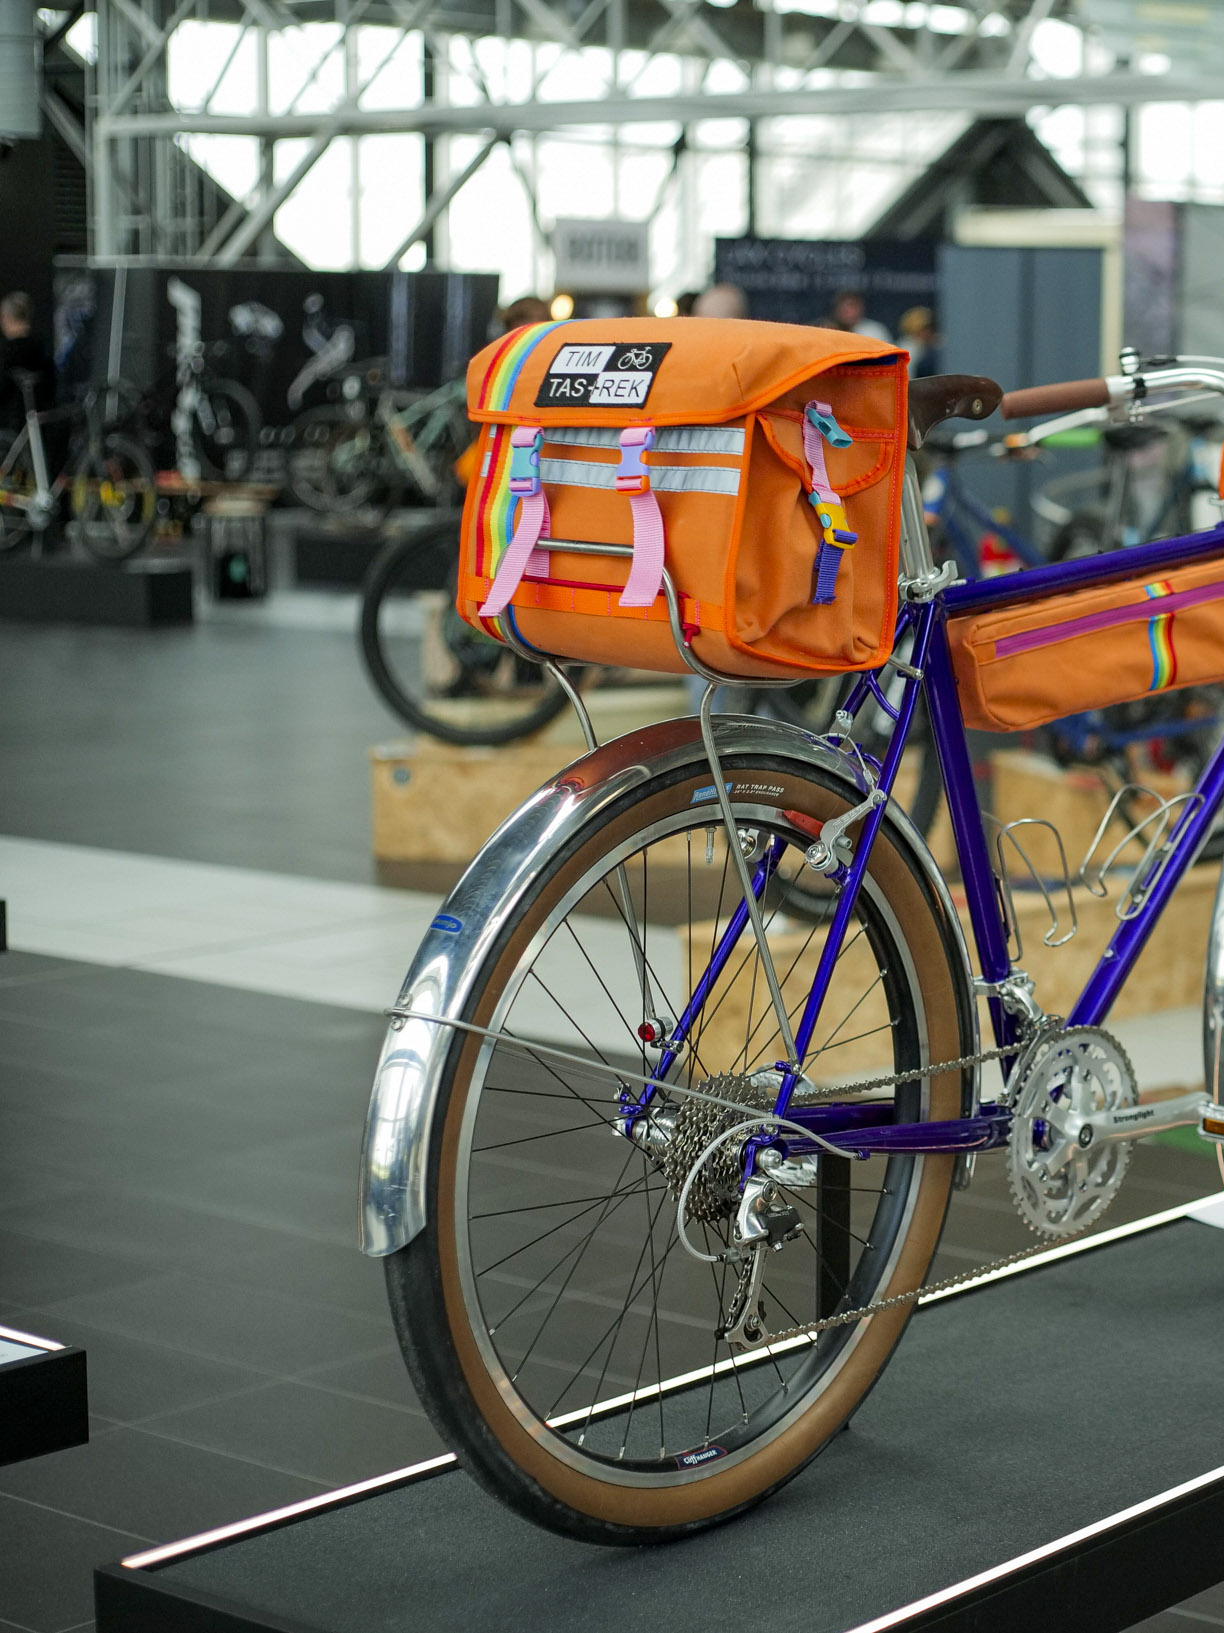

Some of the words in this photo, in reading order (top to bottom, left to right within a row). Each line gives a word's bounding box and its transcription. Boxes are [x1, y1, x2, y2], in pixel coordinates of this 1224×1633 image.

[566, 351, 603, 367] TIM
[768, 785, 785, 793] PASS
[1113, 1109, 1154, 1124] Stronglight
